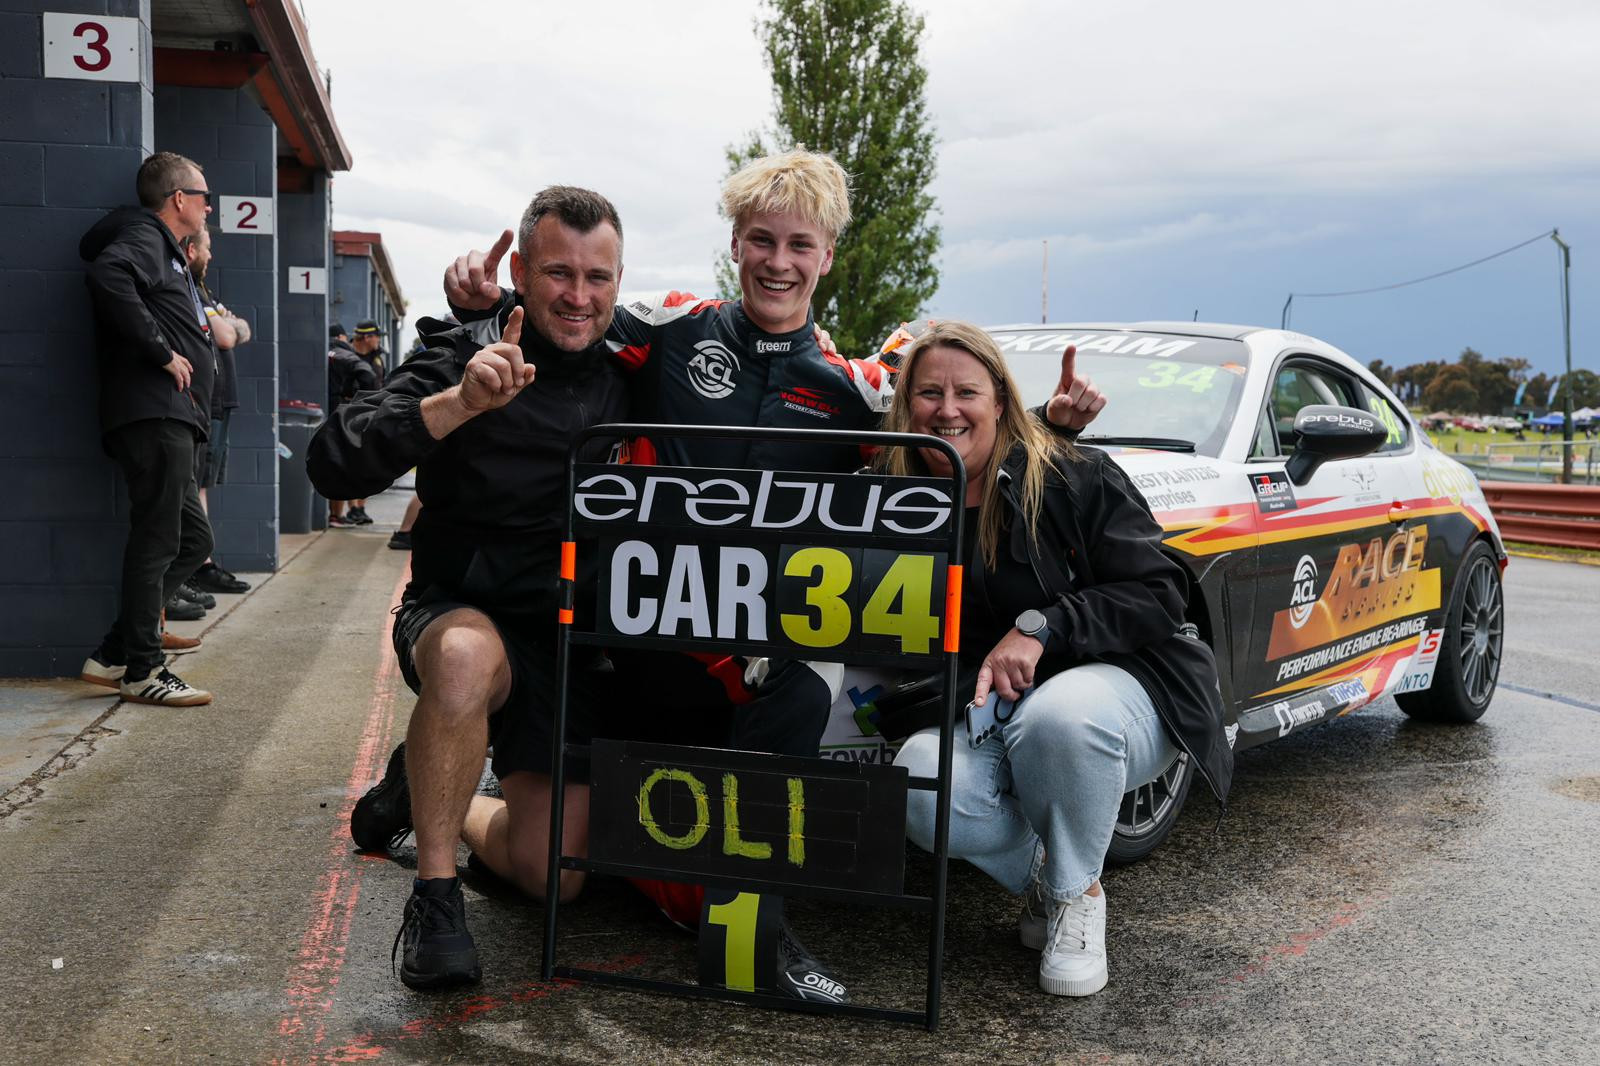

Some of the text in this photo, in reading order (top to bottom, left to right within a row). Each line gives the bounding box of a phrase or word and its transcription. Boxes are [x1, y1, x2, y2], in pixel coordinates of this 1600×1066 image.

[72, 21, 112, 72] 3
[236, 201, 258, 229] 2
[299, 270, 312, 290] 1
[756, 340, 792, 353] freem
[688, 353, 736, 388] ACL
[1138, 361, 1217, 393] 34
[1158, 466, 1220, 486] PLANTERS
[574, 471, 952, 534] erebus
[1322, 524, 1428, 600] RACE
[610, 539, 940, 655] CAR 34
[1290, 580, 1317, 606] ACL
[1276, 616, 1428, 682] PERFORMANCE ENGINE BEARINGS
[639, 768, 805, 869] OLI
[708, 891, 760, 993] 1
[803, 972, 846, 997] OMP
